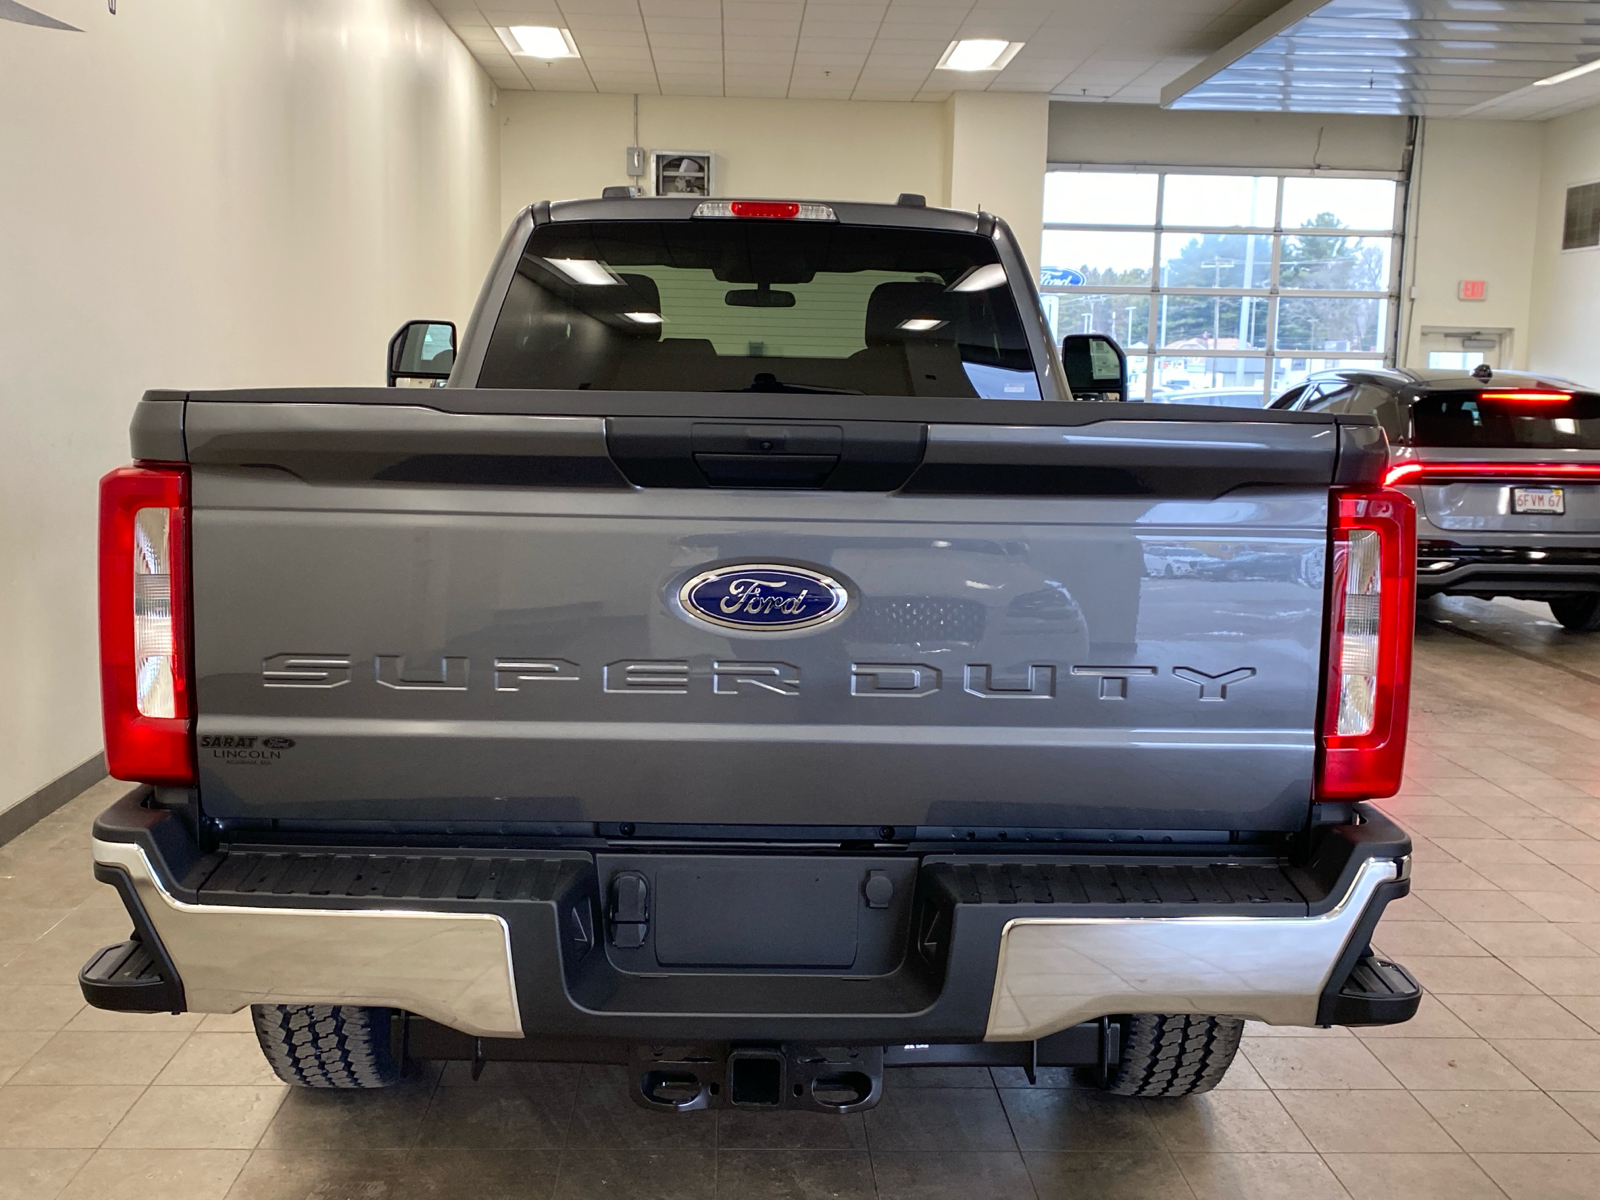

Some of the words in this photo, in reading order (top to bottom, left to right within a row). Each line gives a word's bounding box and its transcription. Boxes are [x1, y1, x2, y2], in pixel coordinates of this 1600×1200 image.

[1041, 271, 1072, 286] Ford
[1548, 494, 1561, 507] 67
[720, 578, 809, 615] Ford
[262, 653, 800, 697] SUPER
[850, 662, 1258, 702] DUTY
[201, 735, 258, 749] SARAT
[266, 739, 290, 748] Ford
[213, 750, 281, 759] LINCOLN
